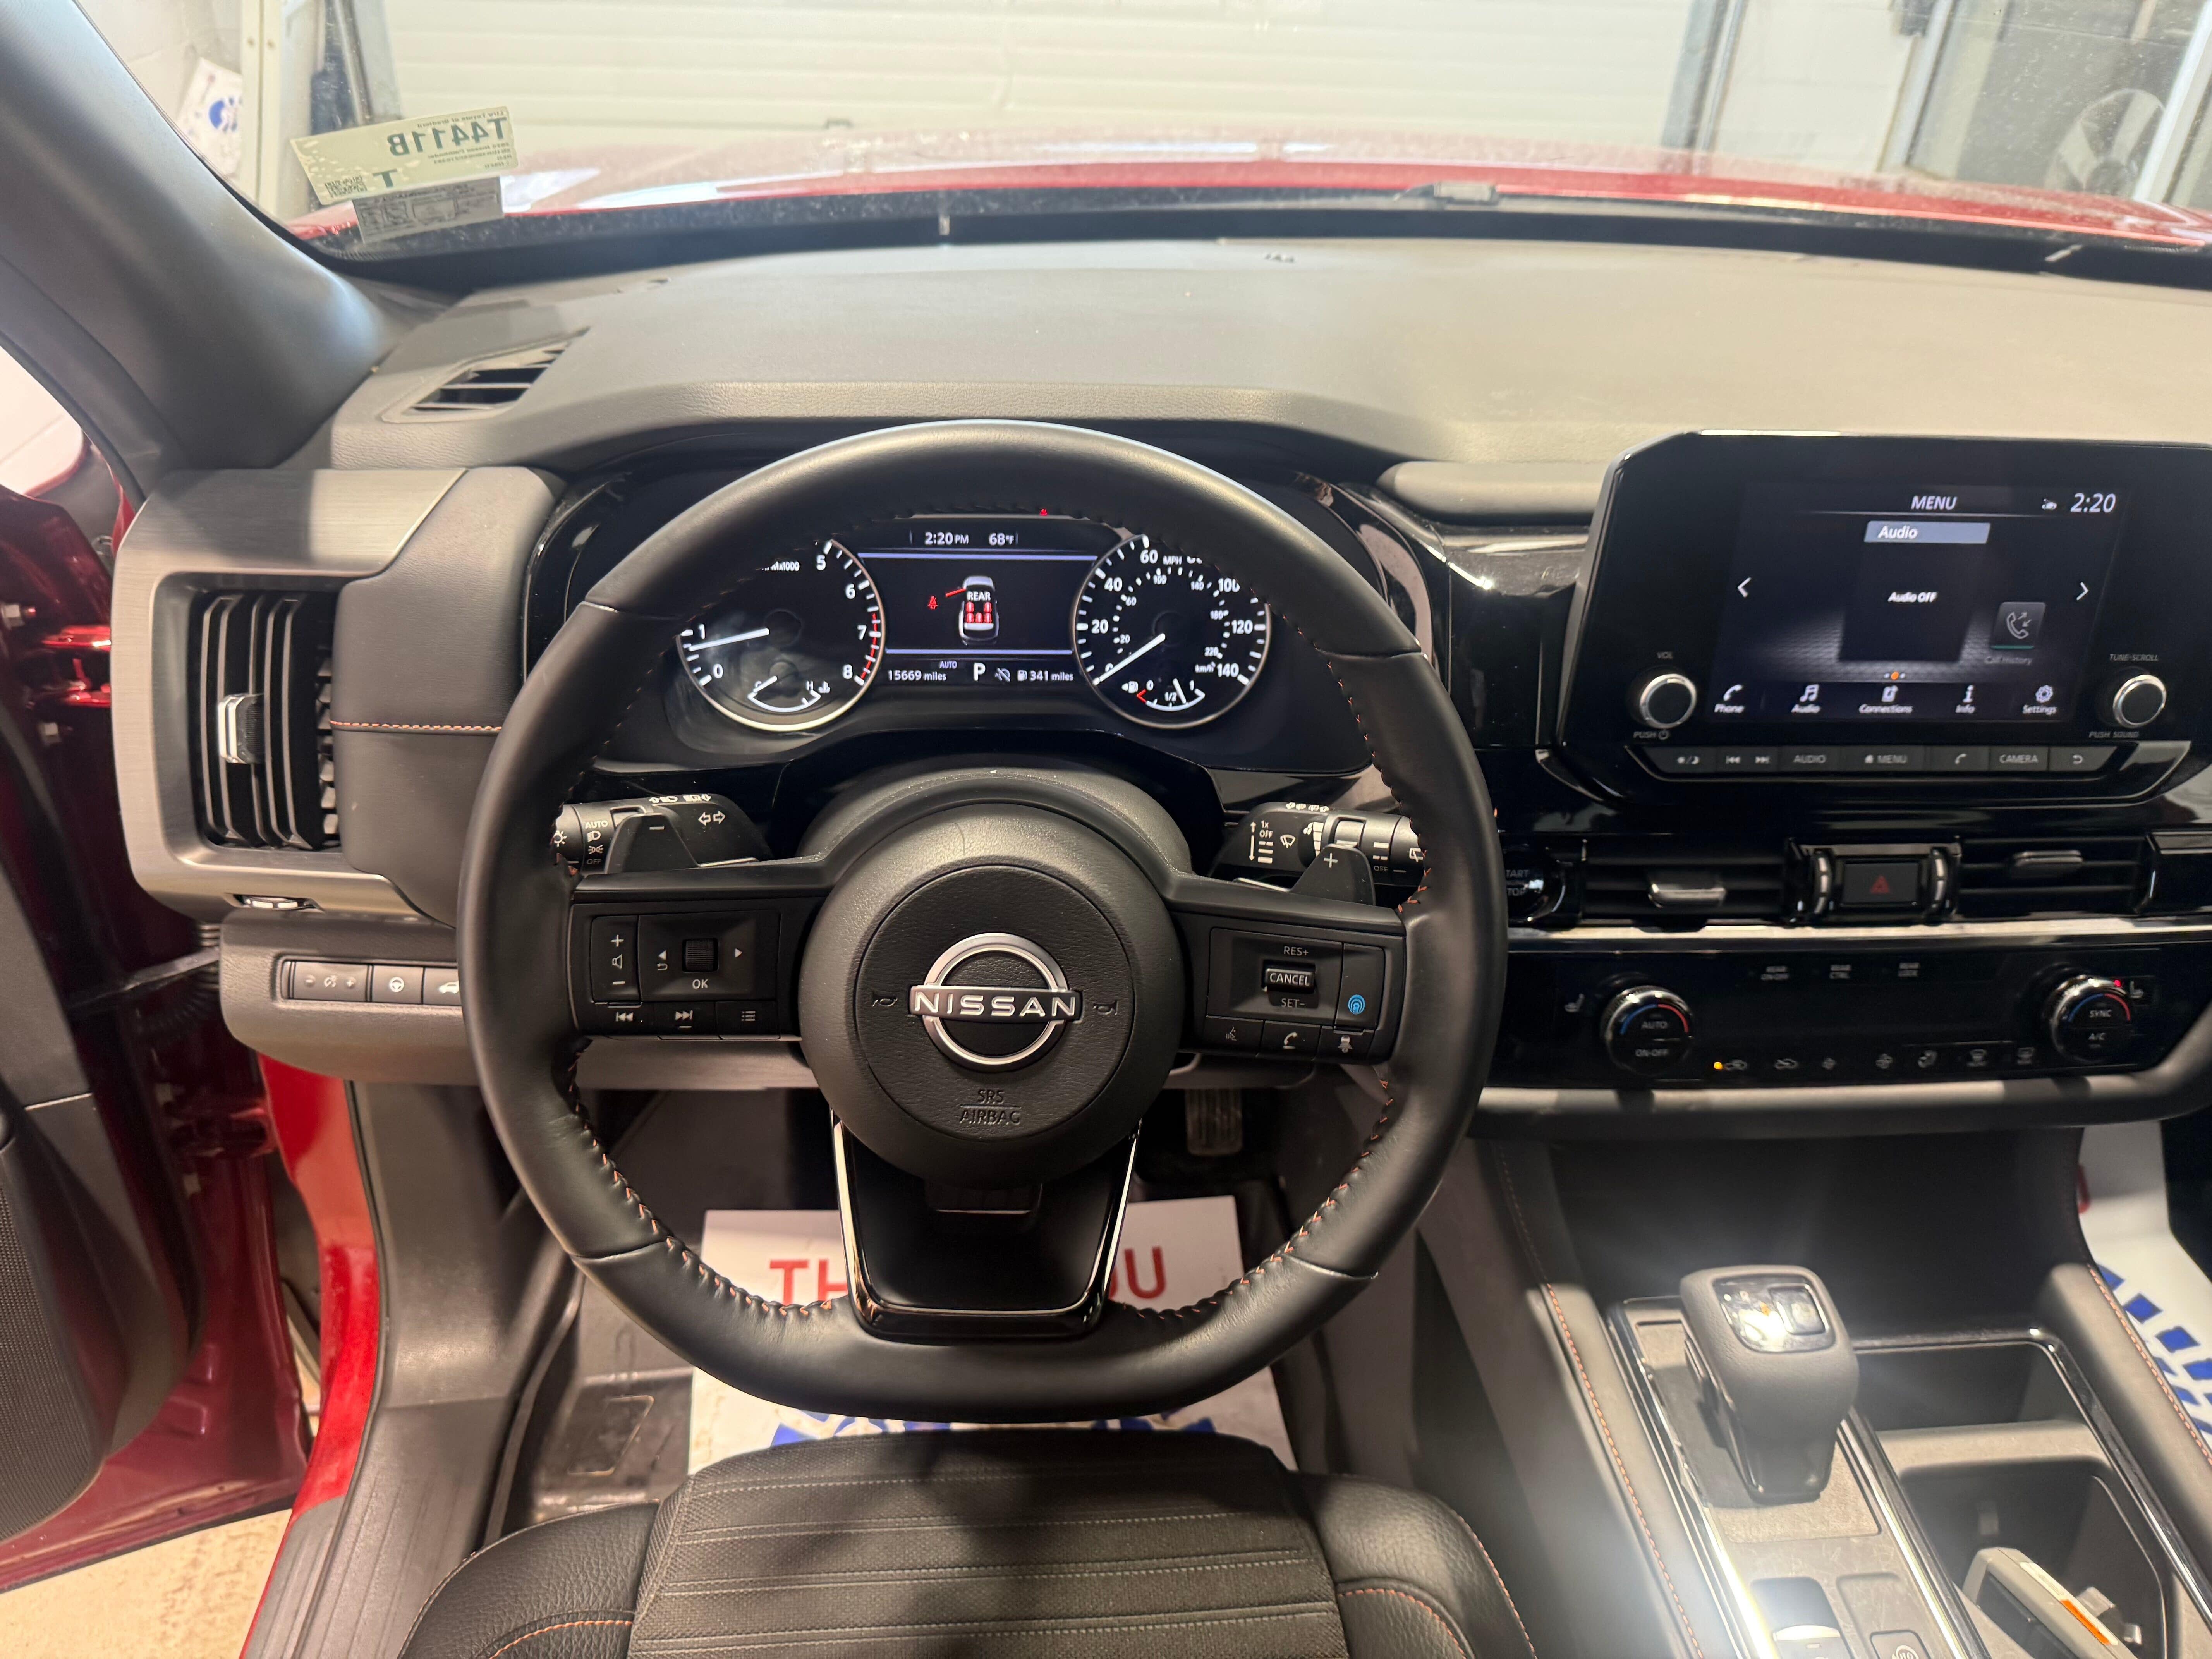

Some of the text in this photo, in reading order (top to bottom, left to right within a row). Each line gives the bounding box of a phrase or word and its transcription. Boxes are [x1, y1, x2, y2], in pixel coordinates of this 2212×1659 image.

[1911, 496, 1957, 510] MENU
[2070, 493, 2116, 513] 2:20
[1878, 526, 1918, 539] Audio
[925, 532, 969, 545] 2:20 PM
[1140, 549, 1158, 564] 60
[1163, 556, 1182, 565] MPH
[816, 555, 826, 571] 5
[1104, 577, 1122, 592] 40
[1153, 575, 1167, 585] 100
[1218, 577, 1240, 592] 100
[845, 584, 855, 599] 6
[967, 592, 991, 601] REAR
[1126, 596, 1137, 606] 60
[1888, 592, 1917, 602] Audio
[699, 624, 706, 639] 1
[1091, 620, 1109, 634] 20
[1231, 620, 1253, 634] 120
[857, 625, 867, 640] 7
[1120, 635, 1130, 644] 20
[1204, 647, 1219, 656] 220
[940, 661, 957, 669] AUTO
[1195, 663, 1214, 673] km/h
[1217, 663, 1239, 677] 140
[713, 665, 723, 678] 0
[843, 665, 853, 678] 8
[888, 670, 946, 681] 15669 miles
[974, 663, 985, 681] P
[1030, 671, 1073, 682] 341 miles
[807, 680, 813, 690] H
[1146, 680, 1154, 690] 0
[1189, 680, 1194, 690] 1
[1714, 704, 1744, 713] Phone
[1791, 704, 1820, 713] Audio
[1859, 704, 1913, 714] Connections
[1956, 705, 1975, 713] Info
[2023, 705, 2057, 715] Settings
[1793, 755, 1826, 763] AUDIO
[1877, 755, 1908, 764] MENU
[1999, 754, 2038, 763] CAMERA
[585, 820, 608, 829] AUTO
[1261, 820, 1269, 829] 1x
[1259, 830, 1273, 839] OFF
[1506, 888, 1525, 896] TOP
[1284, 946, 1309, 957] RES+
[692, 979, 709, 989] OK
[1269, 973, 1310, 986] CANCEL
[914, 991, 1075, 1017] NISSAN
[2090, 1010, 2112, 1018] SYNC
[976, 1089, 1004, 1104] SRS
[959, 1109, 1021, 1125] AIRBAG
